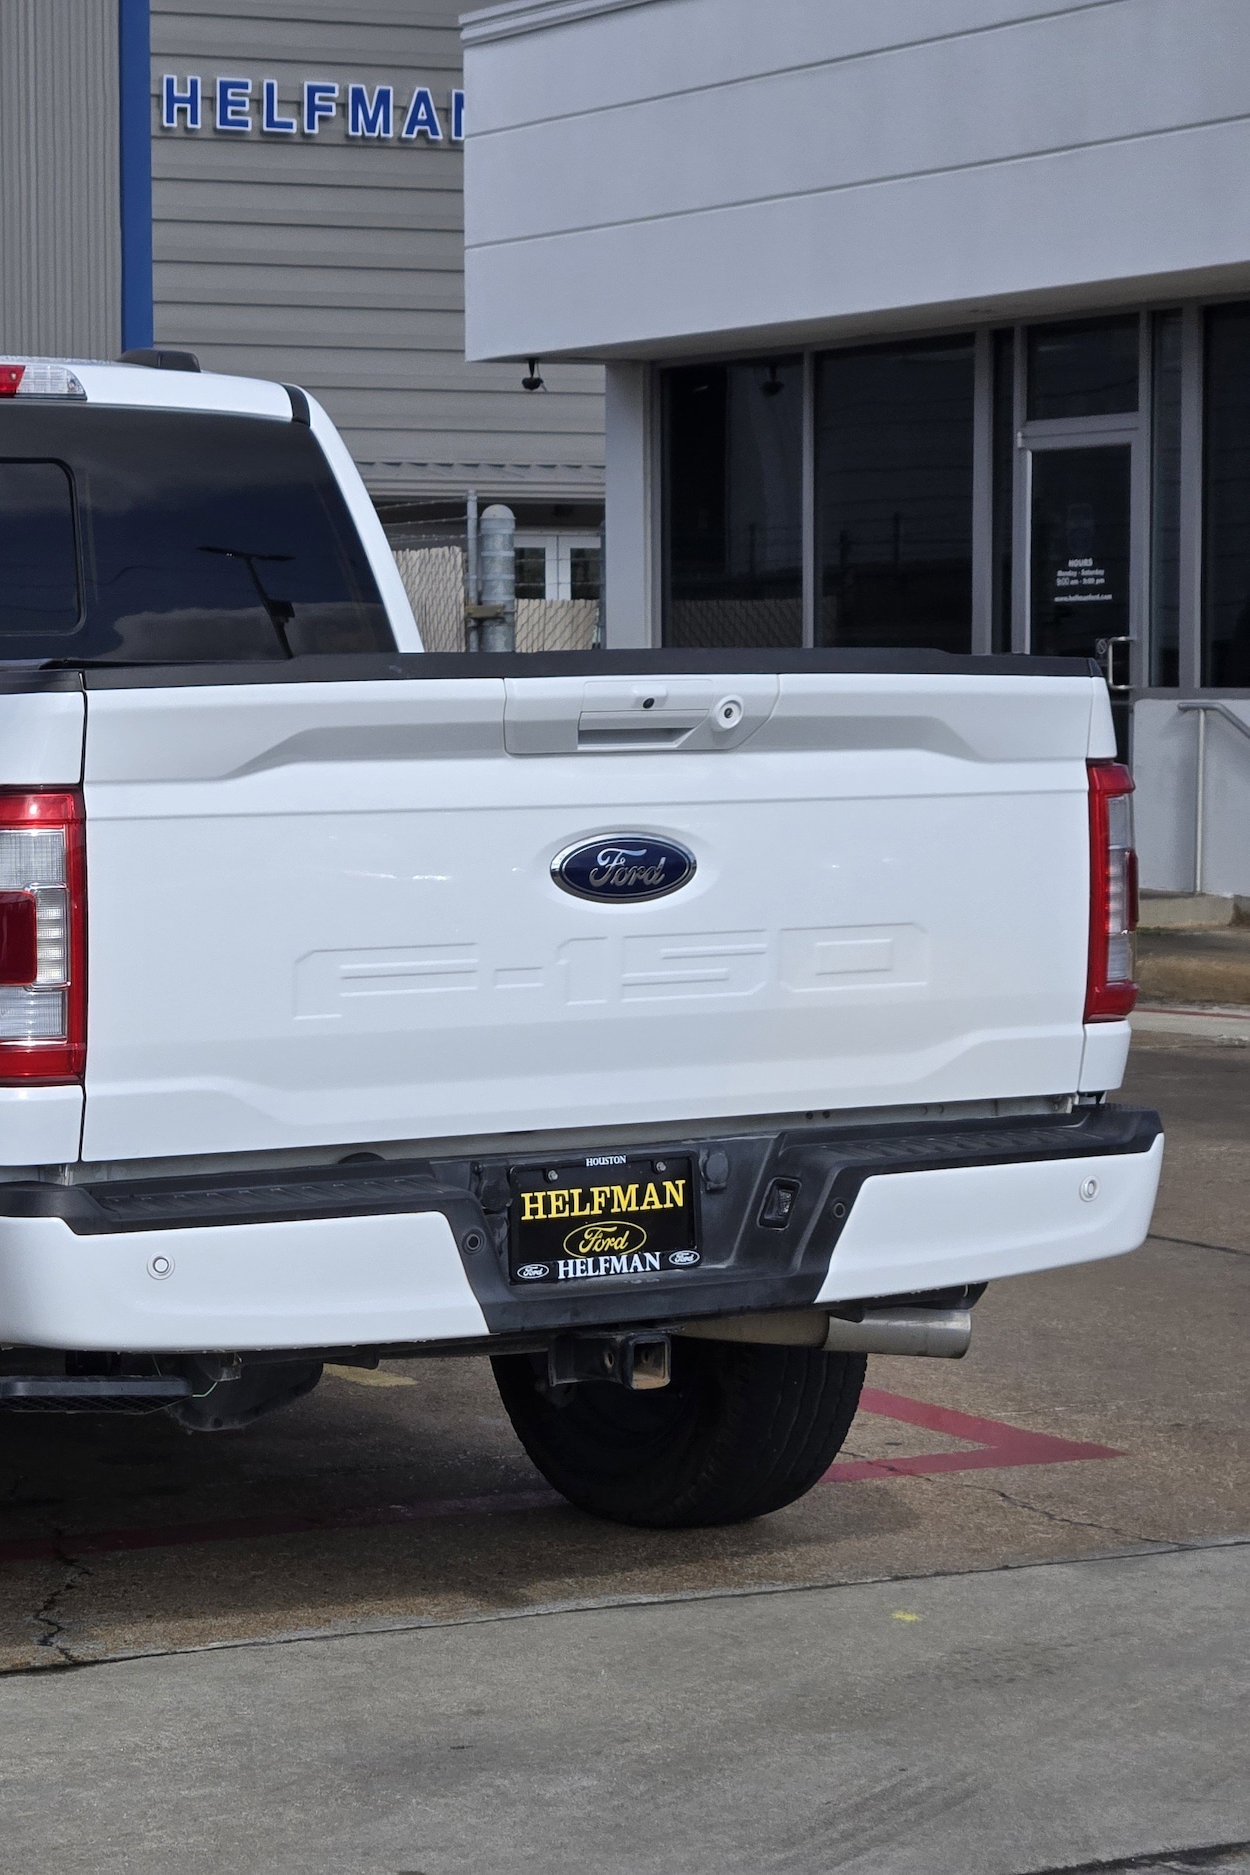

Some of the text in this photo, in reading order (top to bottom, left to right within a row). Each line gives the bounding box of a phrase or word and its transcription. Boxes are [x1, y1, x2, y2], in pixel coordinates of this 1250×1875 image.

[1068, 558, 1093, 567] HOURS
[588, 848, 667, 888] Ford
[293, 922, 928, 1020] F-150
[585, 1155, 627, 1167] HOUSTON
[520, 1179, 687, 1221] HELFMAN
[578, 1225, 631, 1254] Ford
[556, 1251, 662, 1280] HELFMAN
